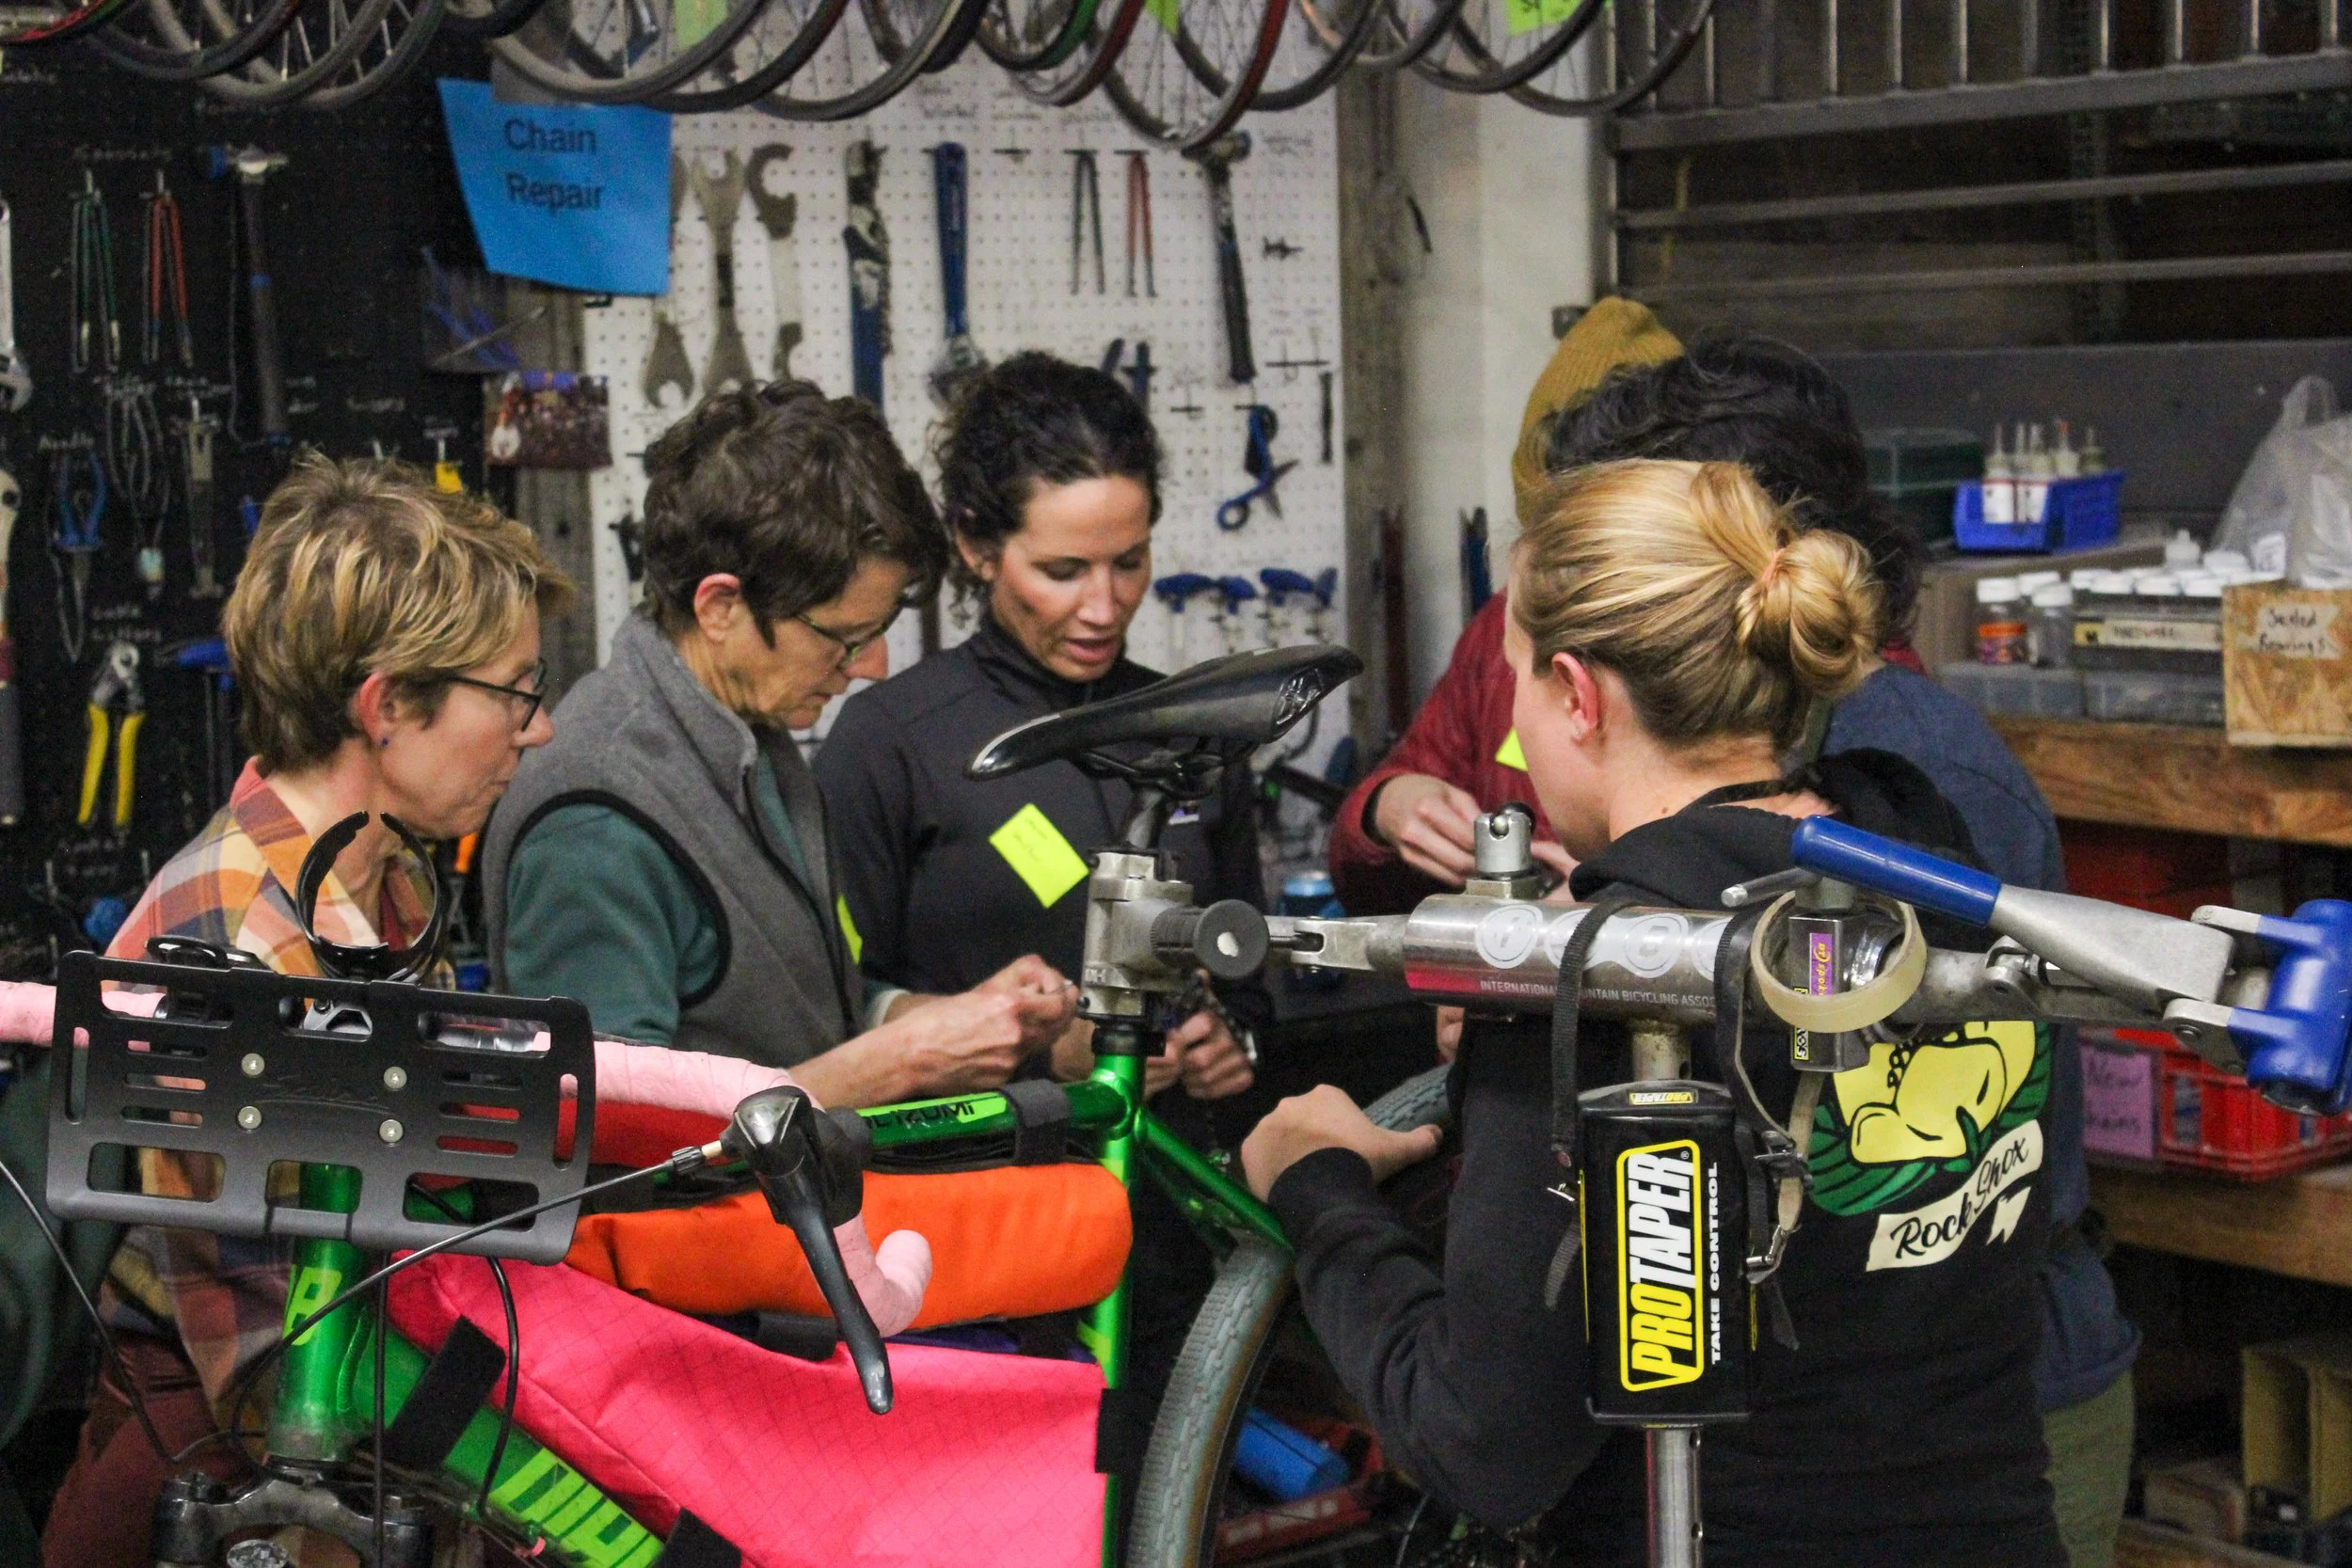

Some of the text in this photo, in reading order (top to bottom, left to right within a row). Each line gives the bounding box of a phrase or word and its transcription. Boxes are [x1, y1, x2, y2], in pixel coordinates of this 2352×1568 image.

[503, 119, 596, 153] Chain
[506, 172, 605, 216] Repair
[1622, 990, 1677, 1006] BICYCLING
[1681, 994, 1716, 1008] ASSOC
[1628, 1153, 1697, 1378] PROTAPER
[1708, 1162, 1721, 1365] TAKE CONTROL
